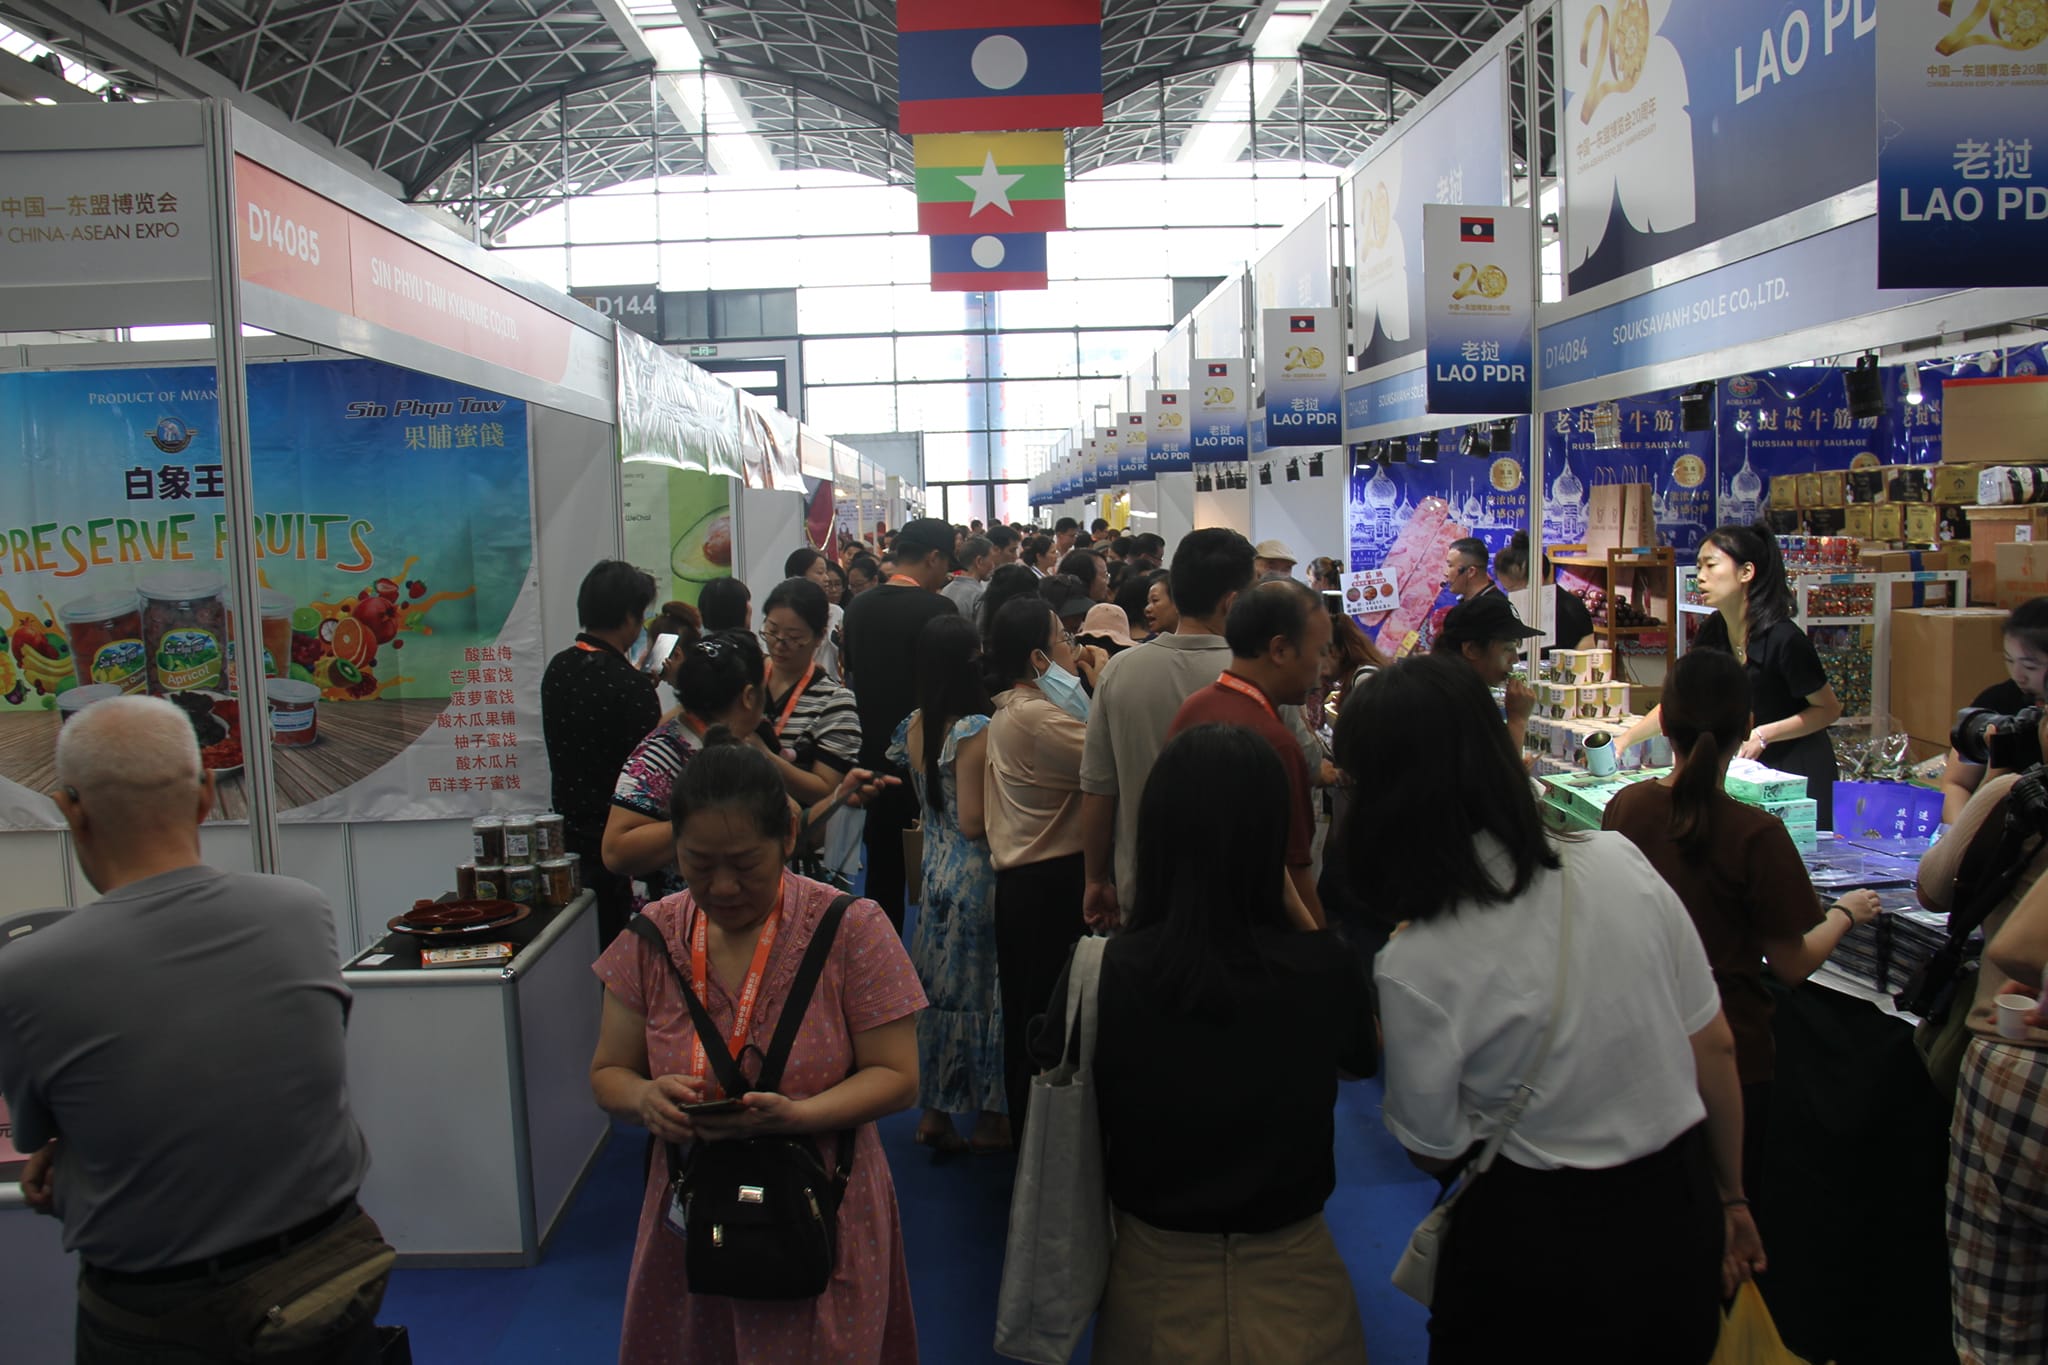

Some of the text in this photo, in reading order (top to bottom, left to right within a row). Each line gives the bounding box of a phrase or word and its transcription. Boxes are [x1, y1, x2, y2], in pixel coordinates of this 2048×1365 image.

[1735, 9, 1810, 105] LAO
[1952, 138, 2033, 180] 老挝
[1900, 187, 2048, 222] LAO PD
[8, 223, 131, 244] CHINA-ASEAN
[136, 221, 180, 240] EXPO
[247, 202, 321, 267] D14085
[371, 256, 393, 290] SIN
[394, 267, 424, 303] PHYU
[425, 281, 448, 311] TAW
[595, 294, 657, 316] D14.4
[1612, 304, 1691, 345] SOUKSAVANH
[1692, 295, 1728, 324] SOLE
[1461, 341, 1500, 362] 老挝
[1545, 336, 1588, 369] D14084
[1436, 364, 1526, 383] LAO PDR
[158, 391, 177, 402] OF
[180, 389, 219, 401] MYAN
[1290, 397, 1320, 412] 老挝
[345, 396, 507, 420] Sin Phyu Taw
[1272, 412, 1338, 426] LAO PDR
[1195, 437, 1218, 447] LAO
[1221, 436, 1245, 446] PDR
[1645, 441, 1691, 449] SAUSAGE
[1751, 438, 1867, 448] RUSSIAN BEEF SAUSAGE
[1150, 452, 1190, 460] LAO PDR
[124, 465, 225, 500] 白象王
[167, 666, 210, 687] Apricot
[450, 667, 514, 685] 芒果蜜饯
[451, 689, 515, 707] 菠萝蜜饯
[454, 732, 518, 750] 柚子蜜饯
[456, 753, 519, 771] 酸木瓜片
[427, 775, 521, 793] 西洋李子蜜饯
